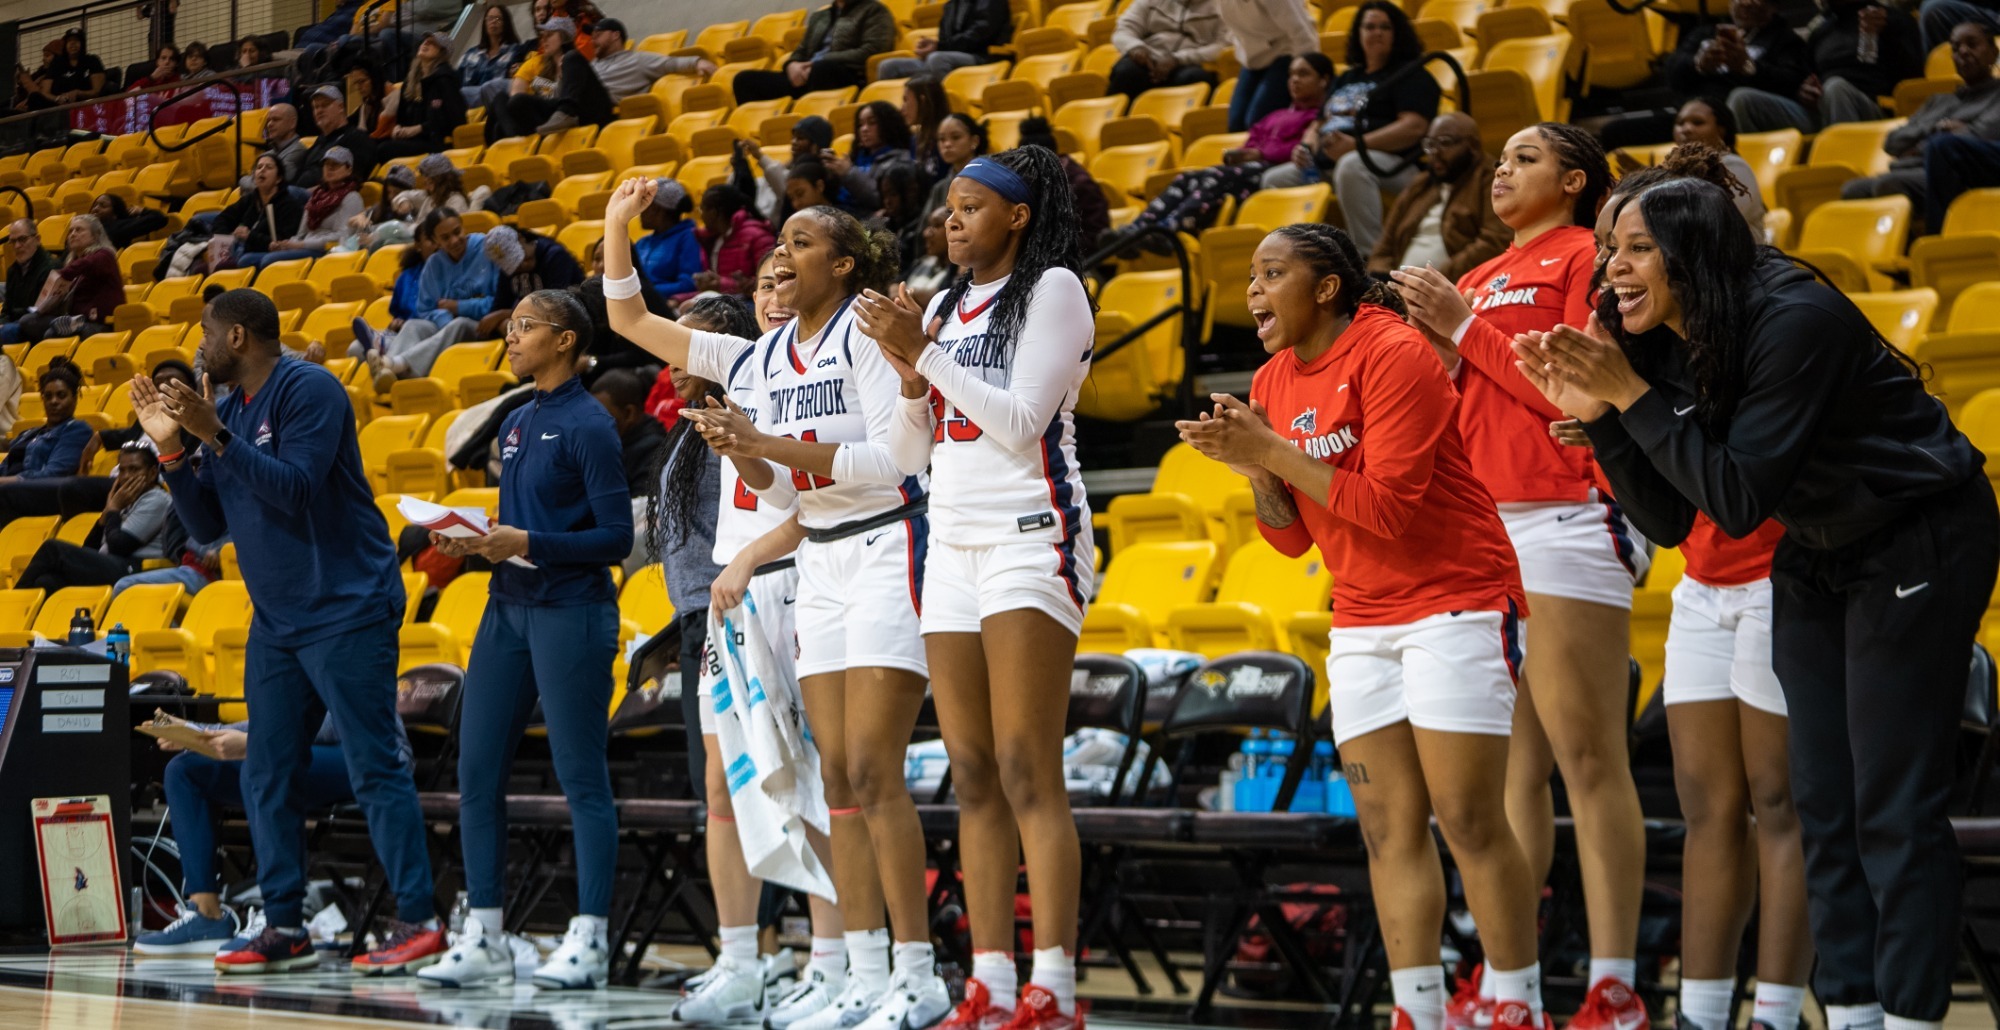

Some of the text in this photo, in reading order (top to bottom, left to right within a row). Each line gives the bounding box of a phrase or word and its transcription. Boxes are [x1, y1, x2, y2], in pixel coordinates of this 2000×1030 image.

[817, 356, 838, 369] CAA
[796, 378, 847, 421] BROOK
[1305, 424, 1360, 459] BROOK
[60, 668, 81, 681] ROY
[57, 692, 84, 705] TONI
[57, 717, 91, 729] DAVID
